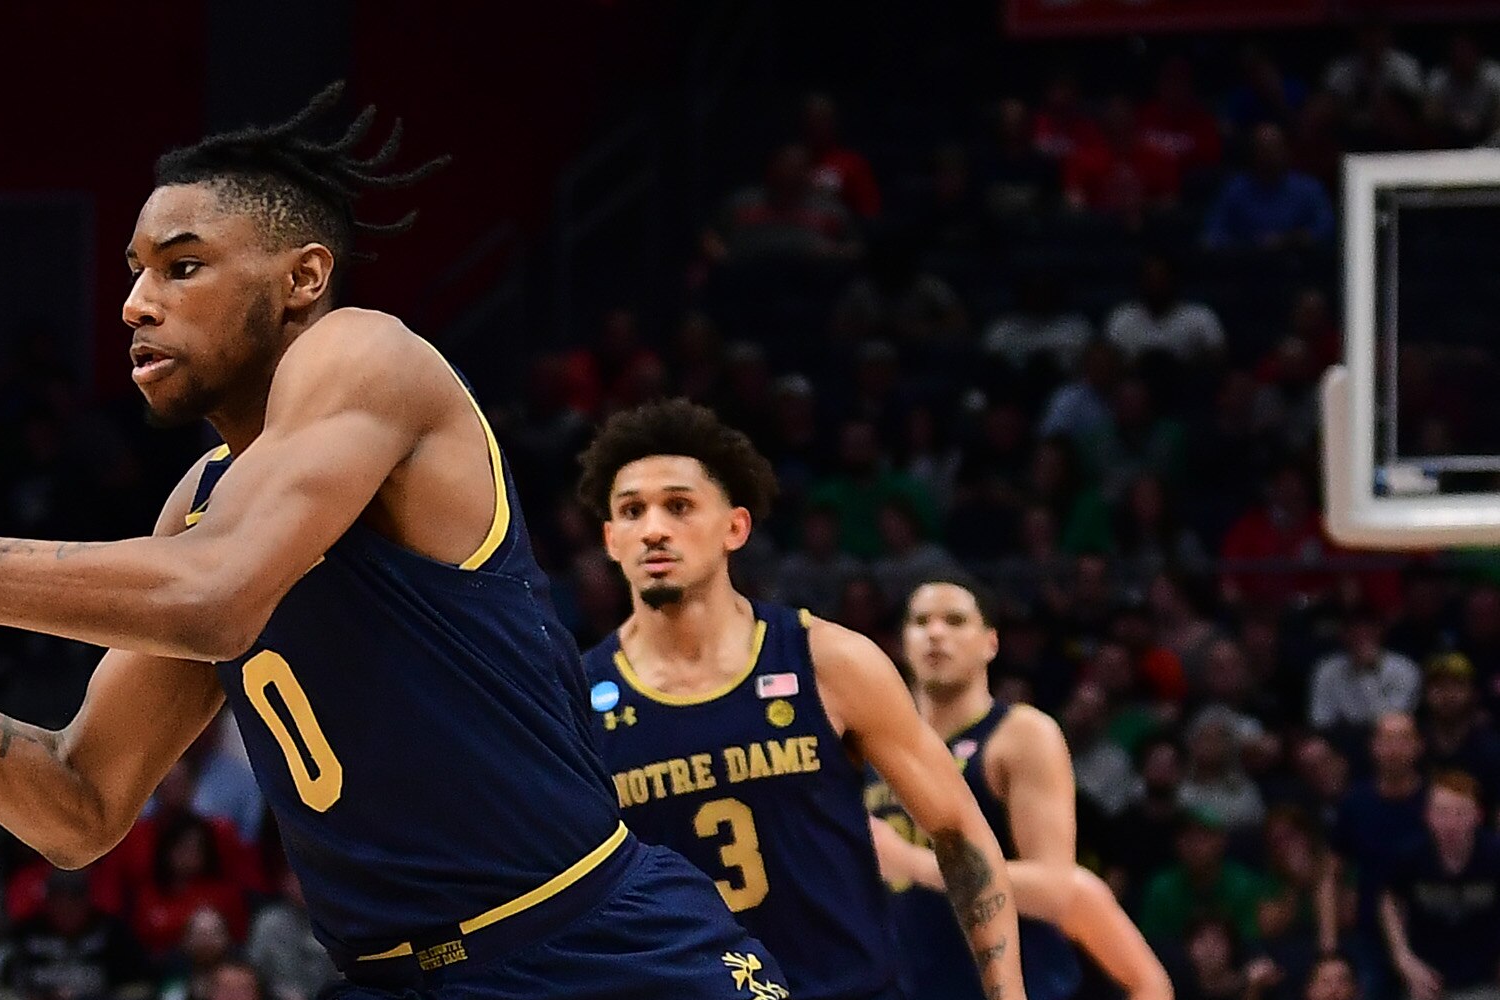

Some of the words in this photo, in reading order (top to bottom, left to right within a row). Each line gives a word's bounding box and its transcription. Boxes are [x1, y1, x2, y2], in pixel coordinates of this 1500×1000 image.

[242, 649, 343, 813] 0
[611, 753, 717, 809] NOTRE
[724, 735, 821, 783] DAME
[692, 796, 770, 913] 3
